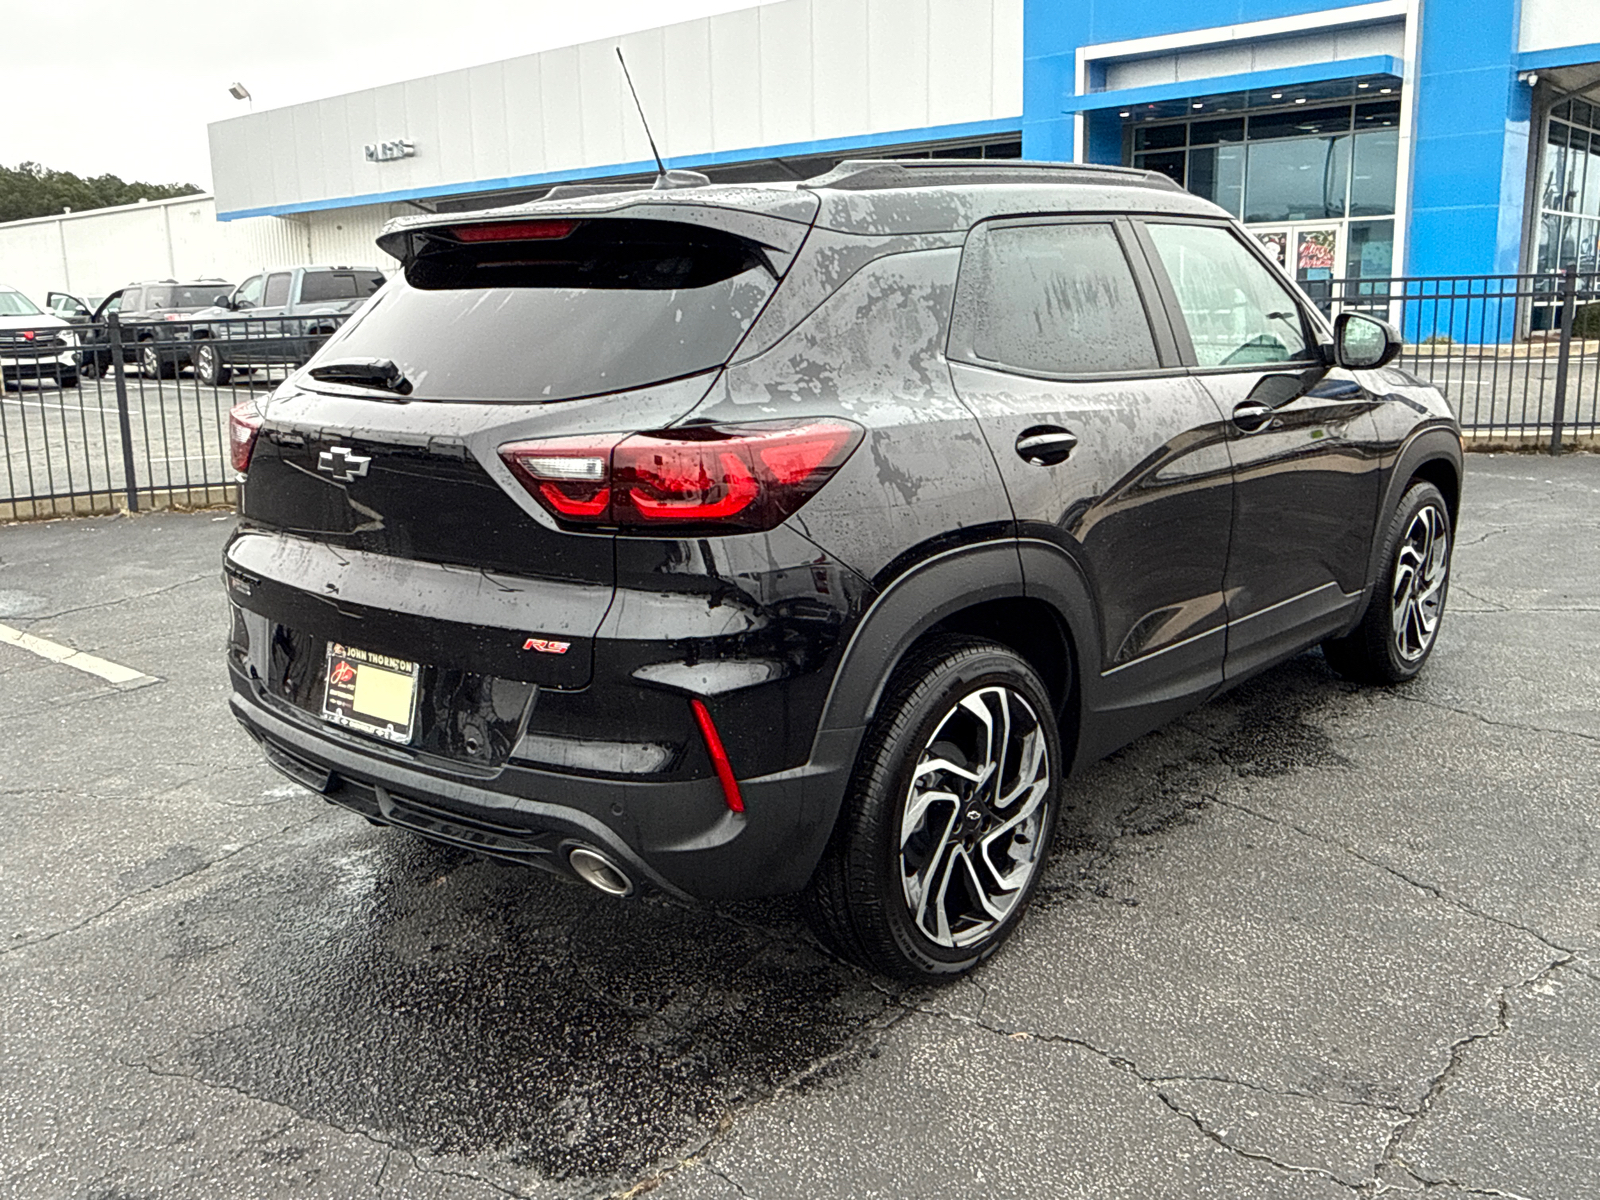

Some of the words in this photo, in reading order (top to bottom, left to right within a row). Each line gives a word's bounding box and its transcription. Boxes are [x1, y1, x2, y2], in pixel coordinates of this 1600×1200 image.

[522, 638, 571, 654] RS
[347, 647, 367, 661] JOHN
[368, 652, 412, 672] THORNTON
